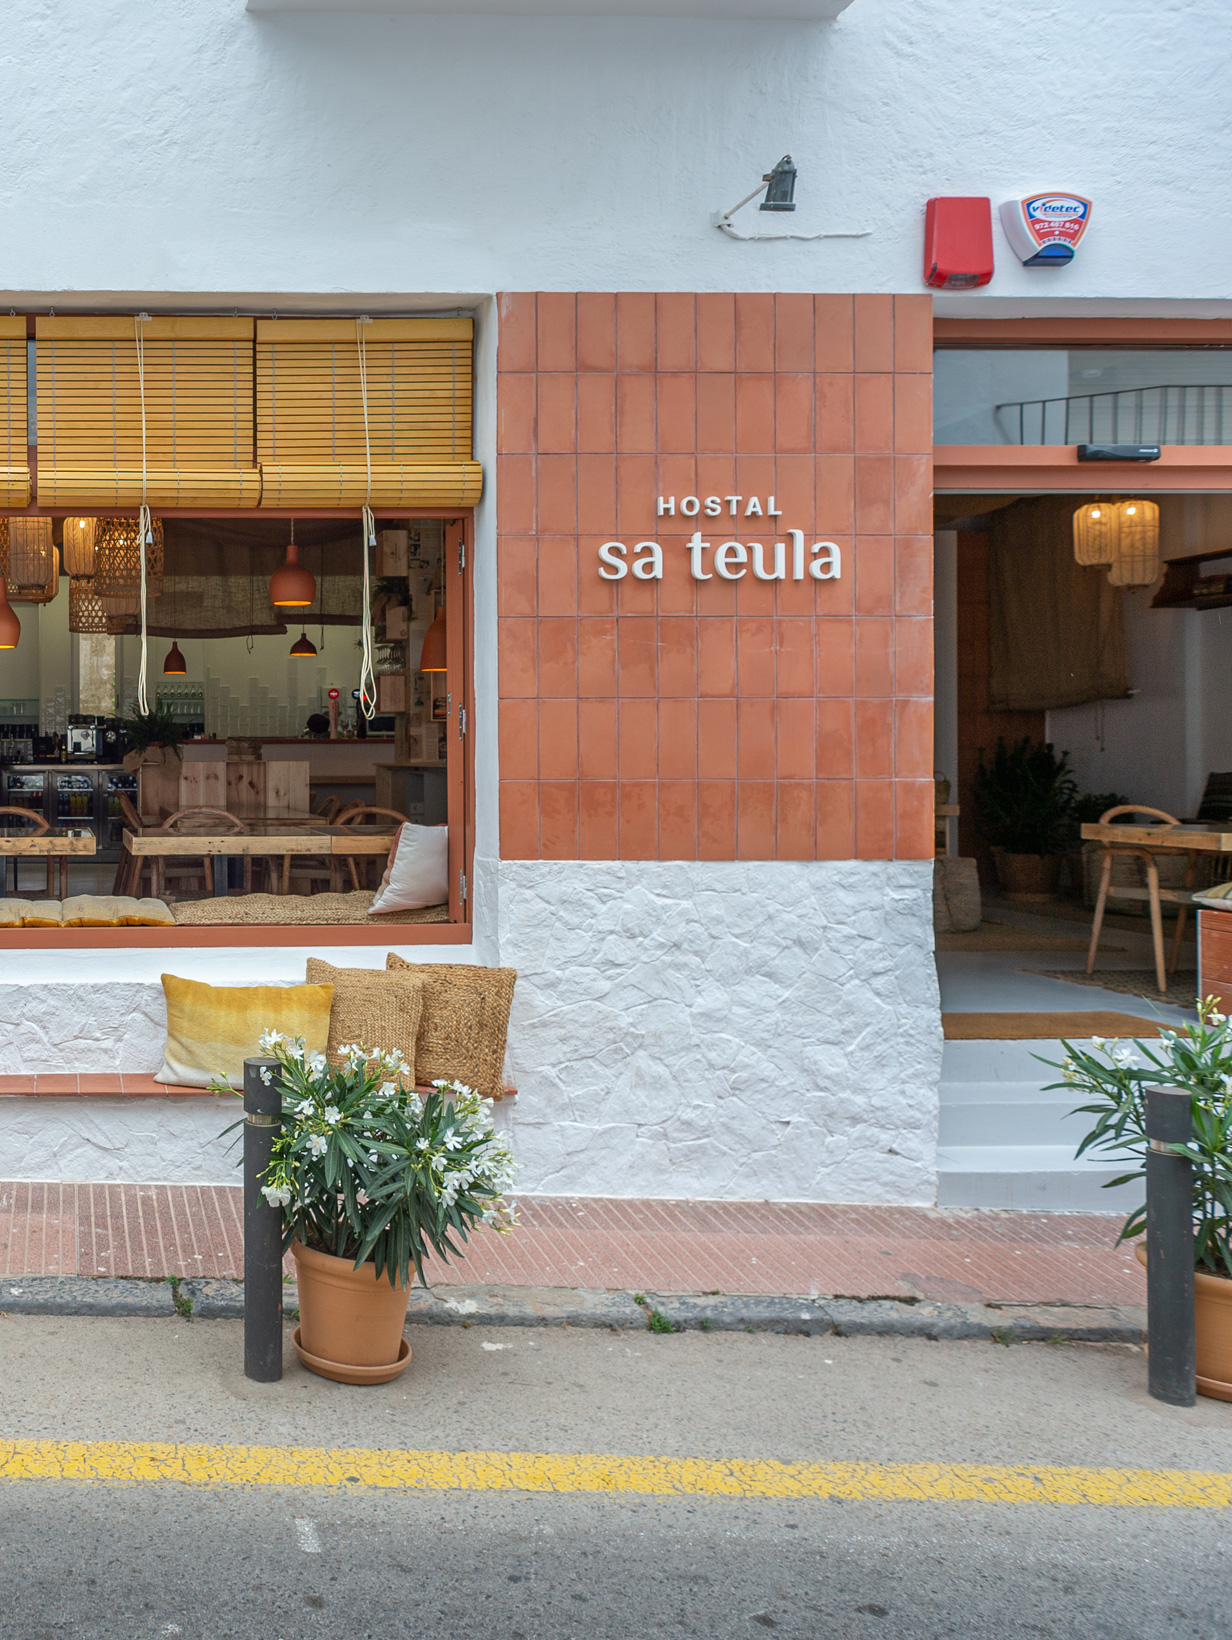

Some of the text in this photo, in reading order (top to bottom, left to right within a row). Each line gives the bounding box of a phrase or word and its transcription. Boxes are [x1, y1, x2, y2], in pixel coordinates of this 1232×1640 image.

[657, 495, 783, 516] HOSTAL
[597, 529, 842, 581] sa teula
